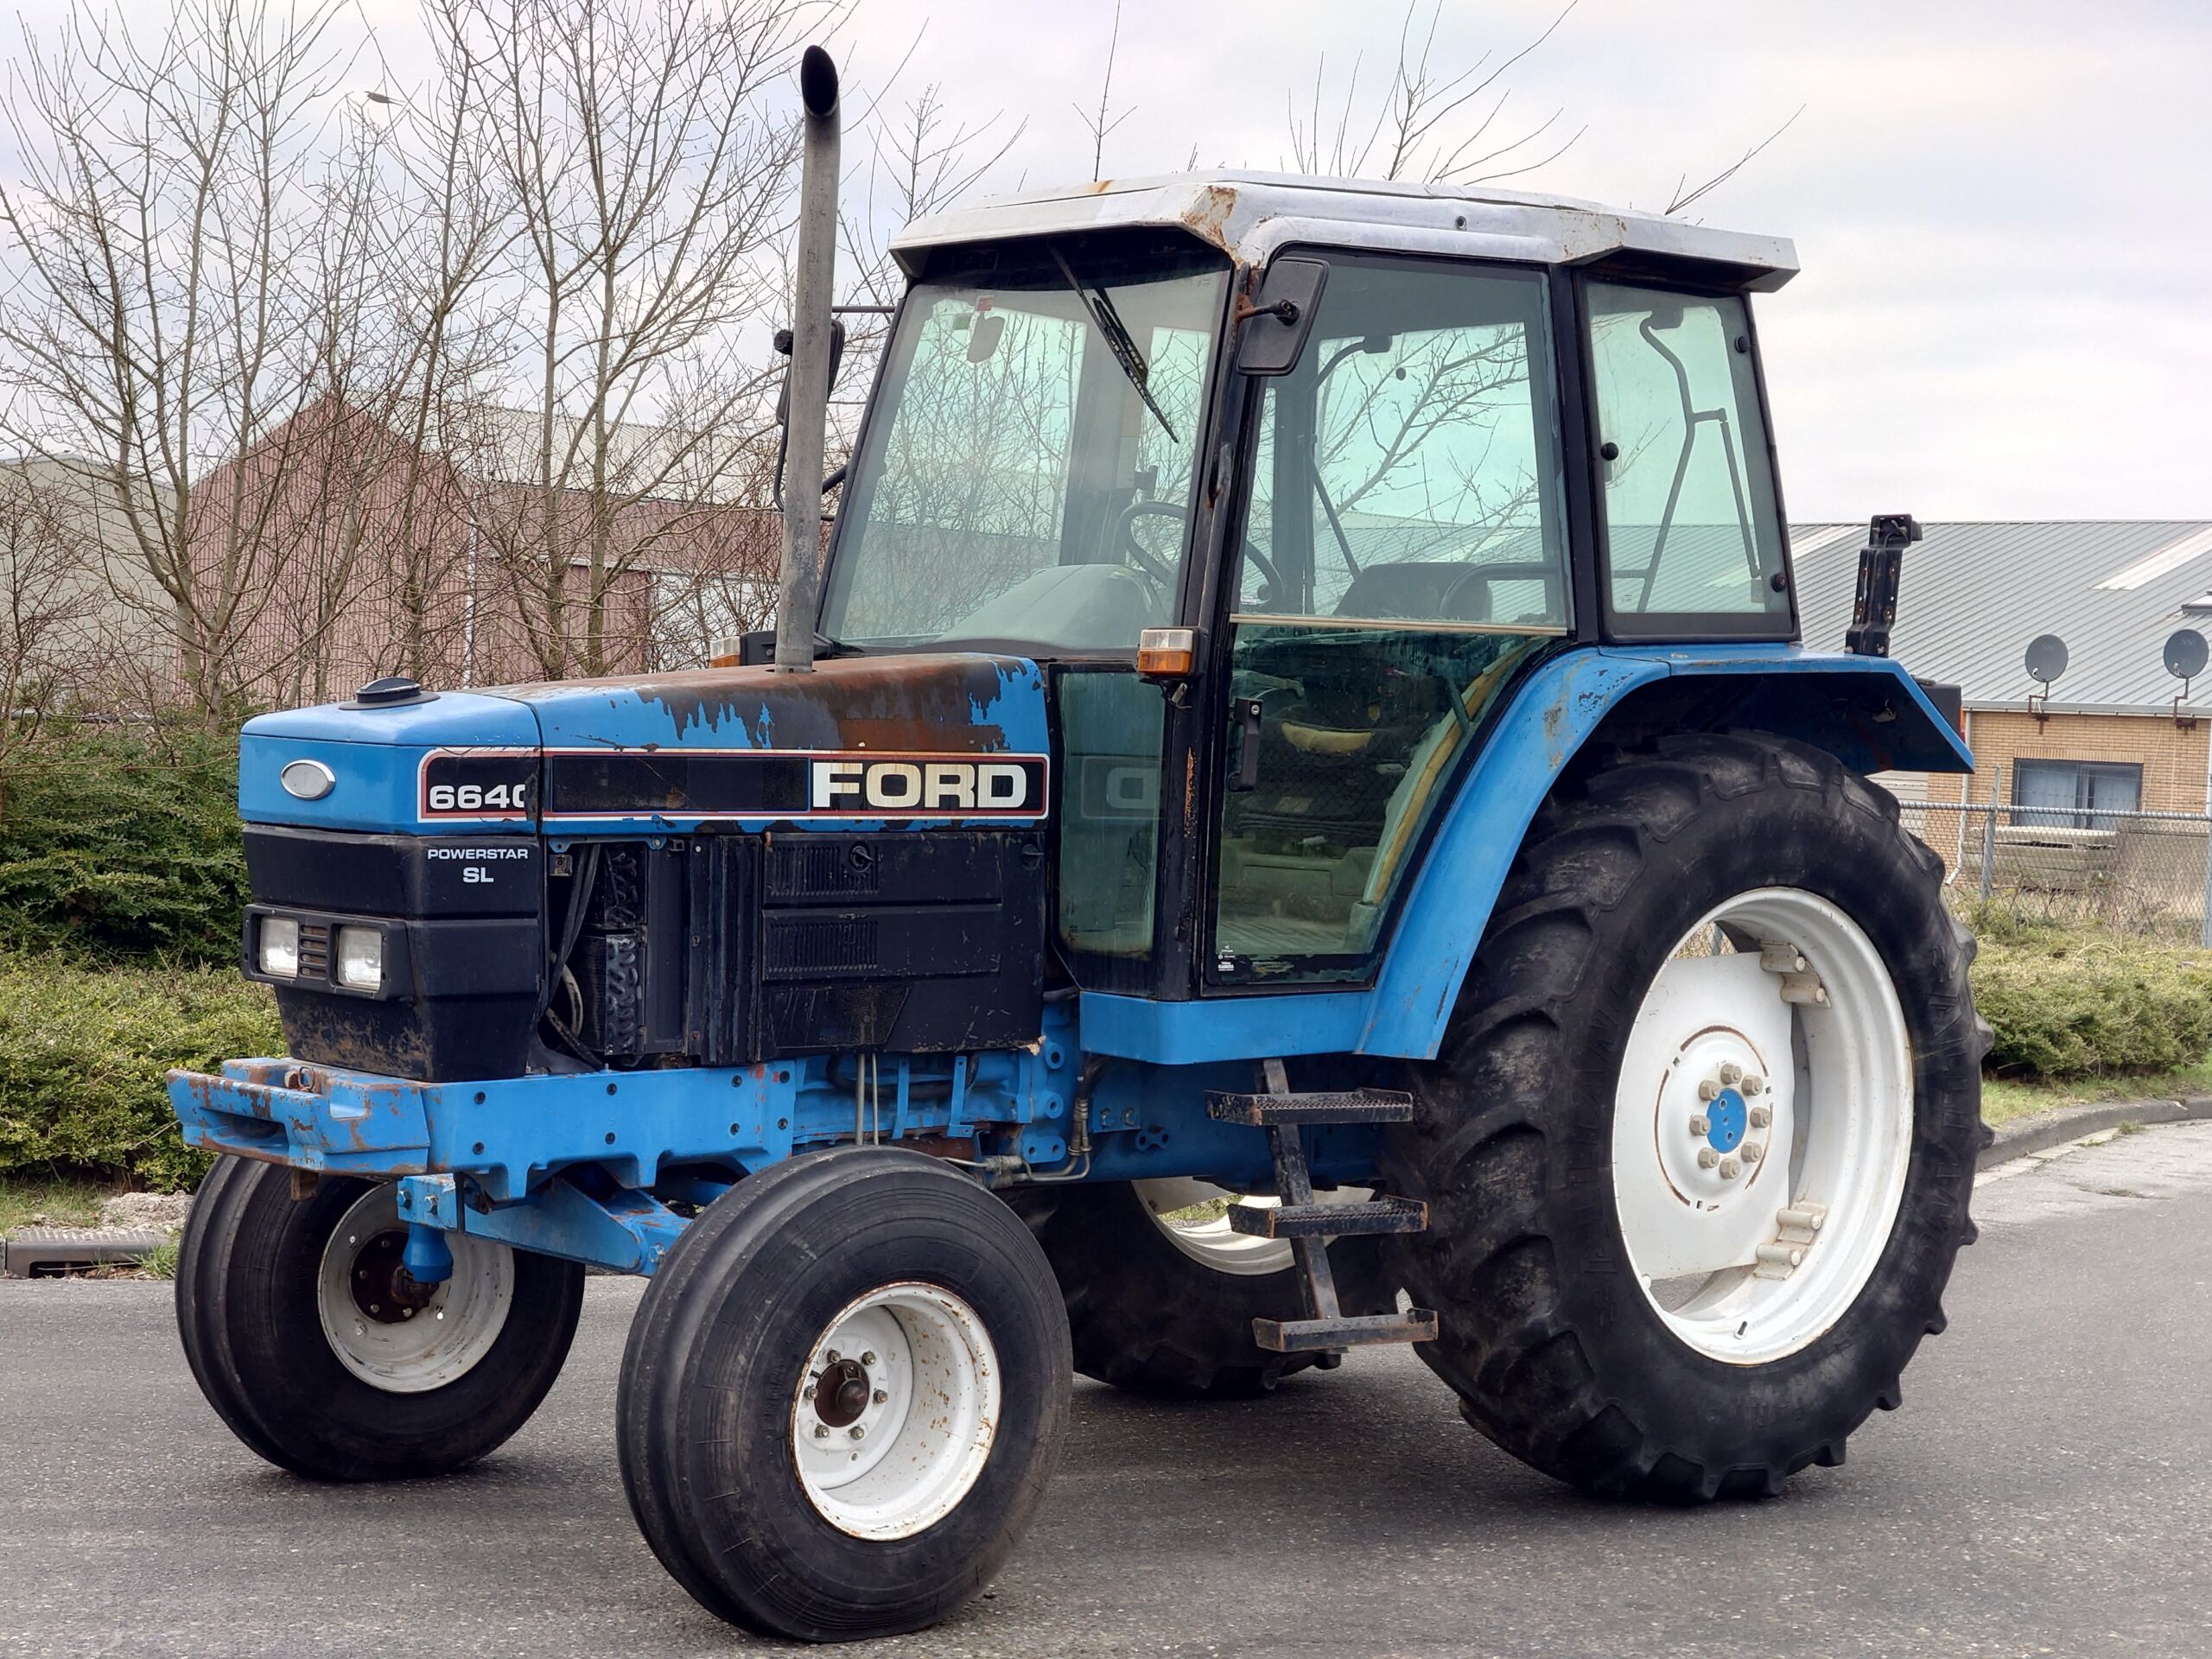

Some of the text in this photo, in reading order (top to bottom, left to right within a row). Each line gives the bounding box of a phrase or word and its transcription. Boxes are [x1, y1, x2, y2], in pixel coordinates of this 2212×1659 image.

[813, 762, 1027, 808] FORD
[428, 849, 529, 860] POWERSTAR
[462, 867, 494, 883] SL
